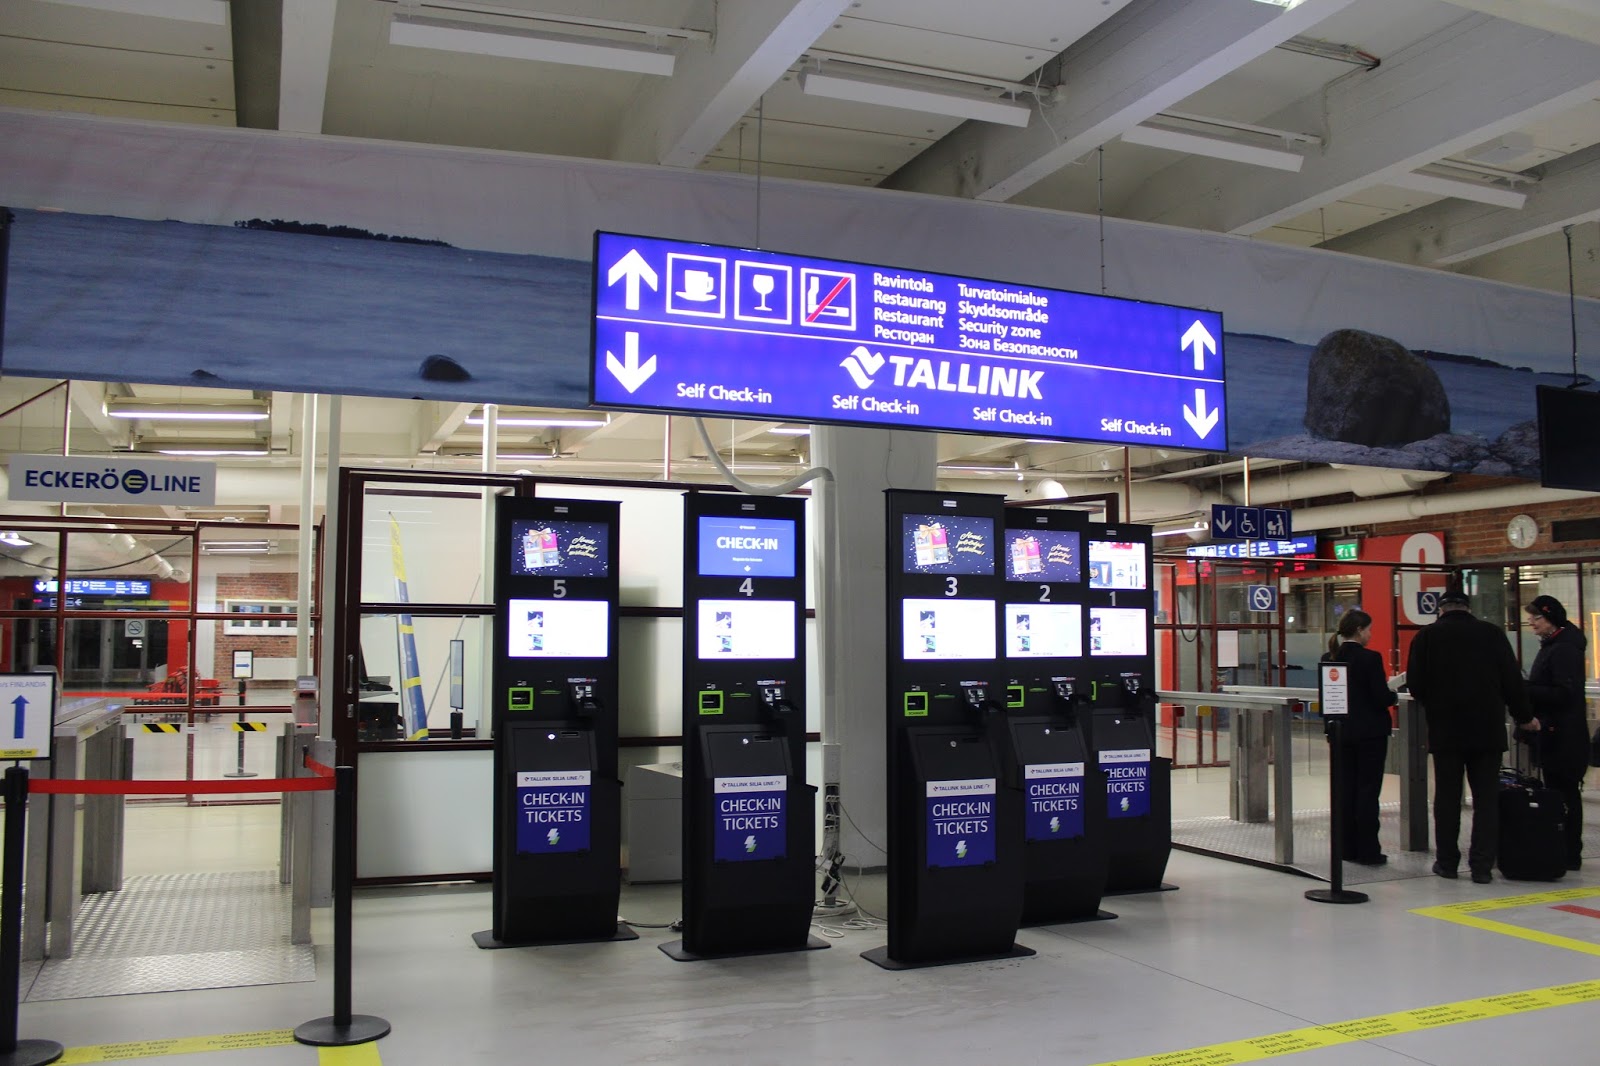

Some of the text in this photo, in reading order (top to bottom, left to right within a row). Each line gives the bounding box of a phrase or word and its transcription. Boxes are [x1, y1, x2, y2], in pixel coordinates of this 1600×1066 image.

[873, 272, 933, 292] Ravintola
[873, 290, 947, 314] Restaurang
[958, 283, 1048, 307] Turvatoimialue
[874, 307, 944, 328] Restaurant
[958, 300, 1049, 323] Skyddsområde
[874, 325, 935, 345] Ресторан
[958, 318, 1041, 339] Security zone
[959, 335, 1078, 359] Зона Безопасности
[889, 355, 1045, 400] TALLINK
[677, 382, 772, 403] Self Check-in
[832, 394, 919, 415] Self Check-in
[973, 406, 1052, 426] Self Check-in
[1101, 418, 1171, 437] Self Check-in
[25, 468, 201, 493] ECKERÖ LINE
[717, 536, 778, 550] CHECK-IN
[1228, 544, 1237, 556] C
[553, 579, 567, 598] 5
[739, 577, 754, 597] 4
[944, 577, 958, 596] 3
[1039, 585, 1051, 603] 2
[1109, 591, 1116, 607] 1
[1030, 782, 1080, 796] CHECK-IN
[1107, 781, 1145, 794] TICKETS
[523, 792, 585, 806] CHECK-IN
[721, 798, 781, 812] CHECK-IN
[1032, 799, 1078, 812] TICKETS
[525, 809, 582, 823] TICKETS
[932, 801, 990, 817] CHECK-IN
[723, 816, 778, 830] TICKETS
[935, 820, 988, 835] TICKETS
